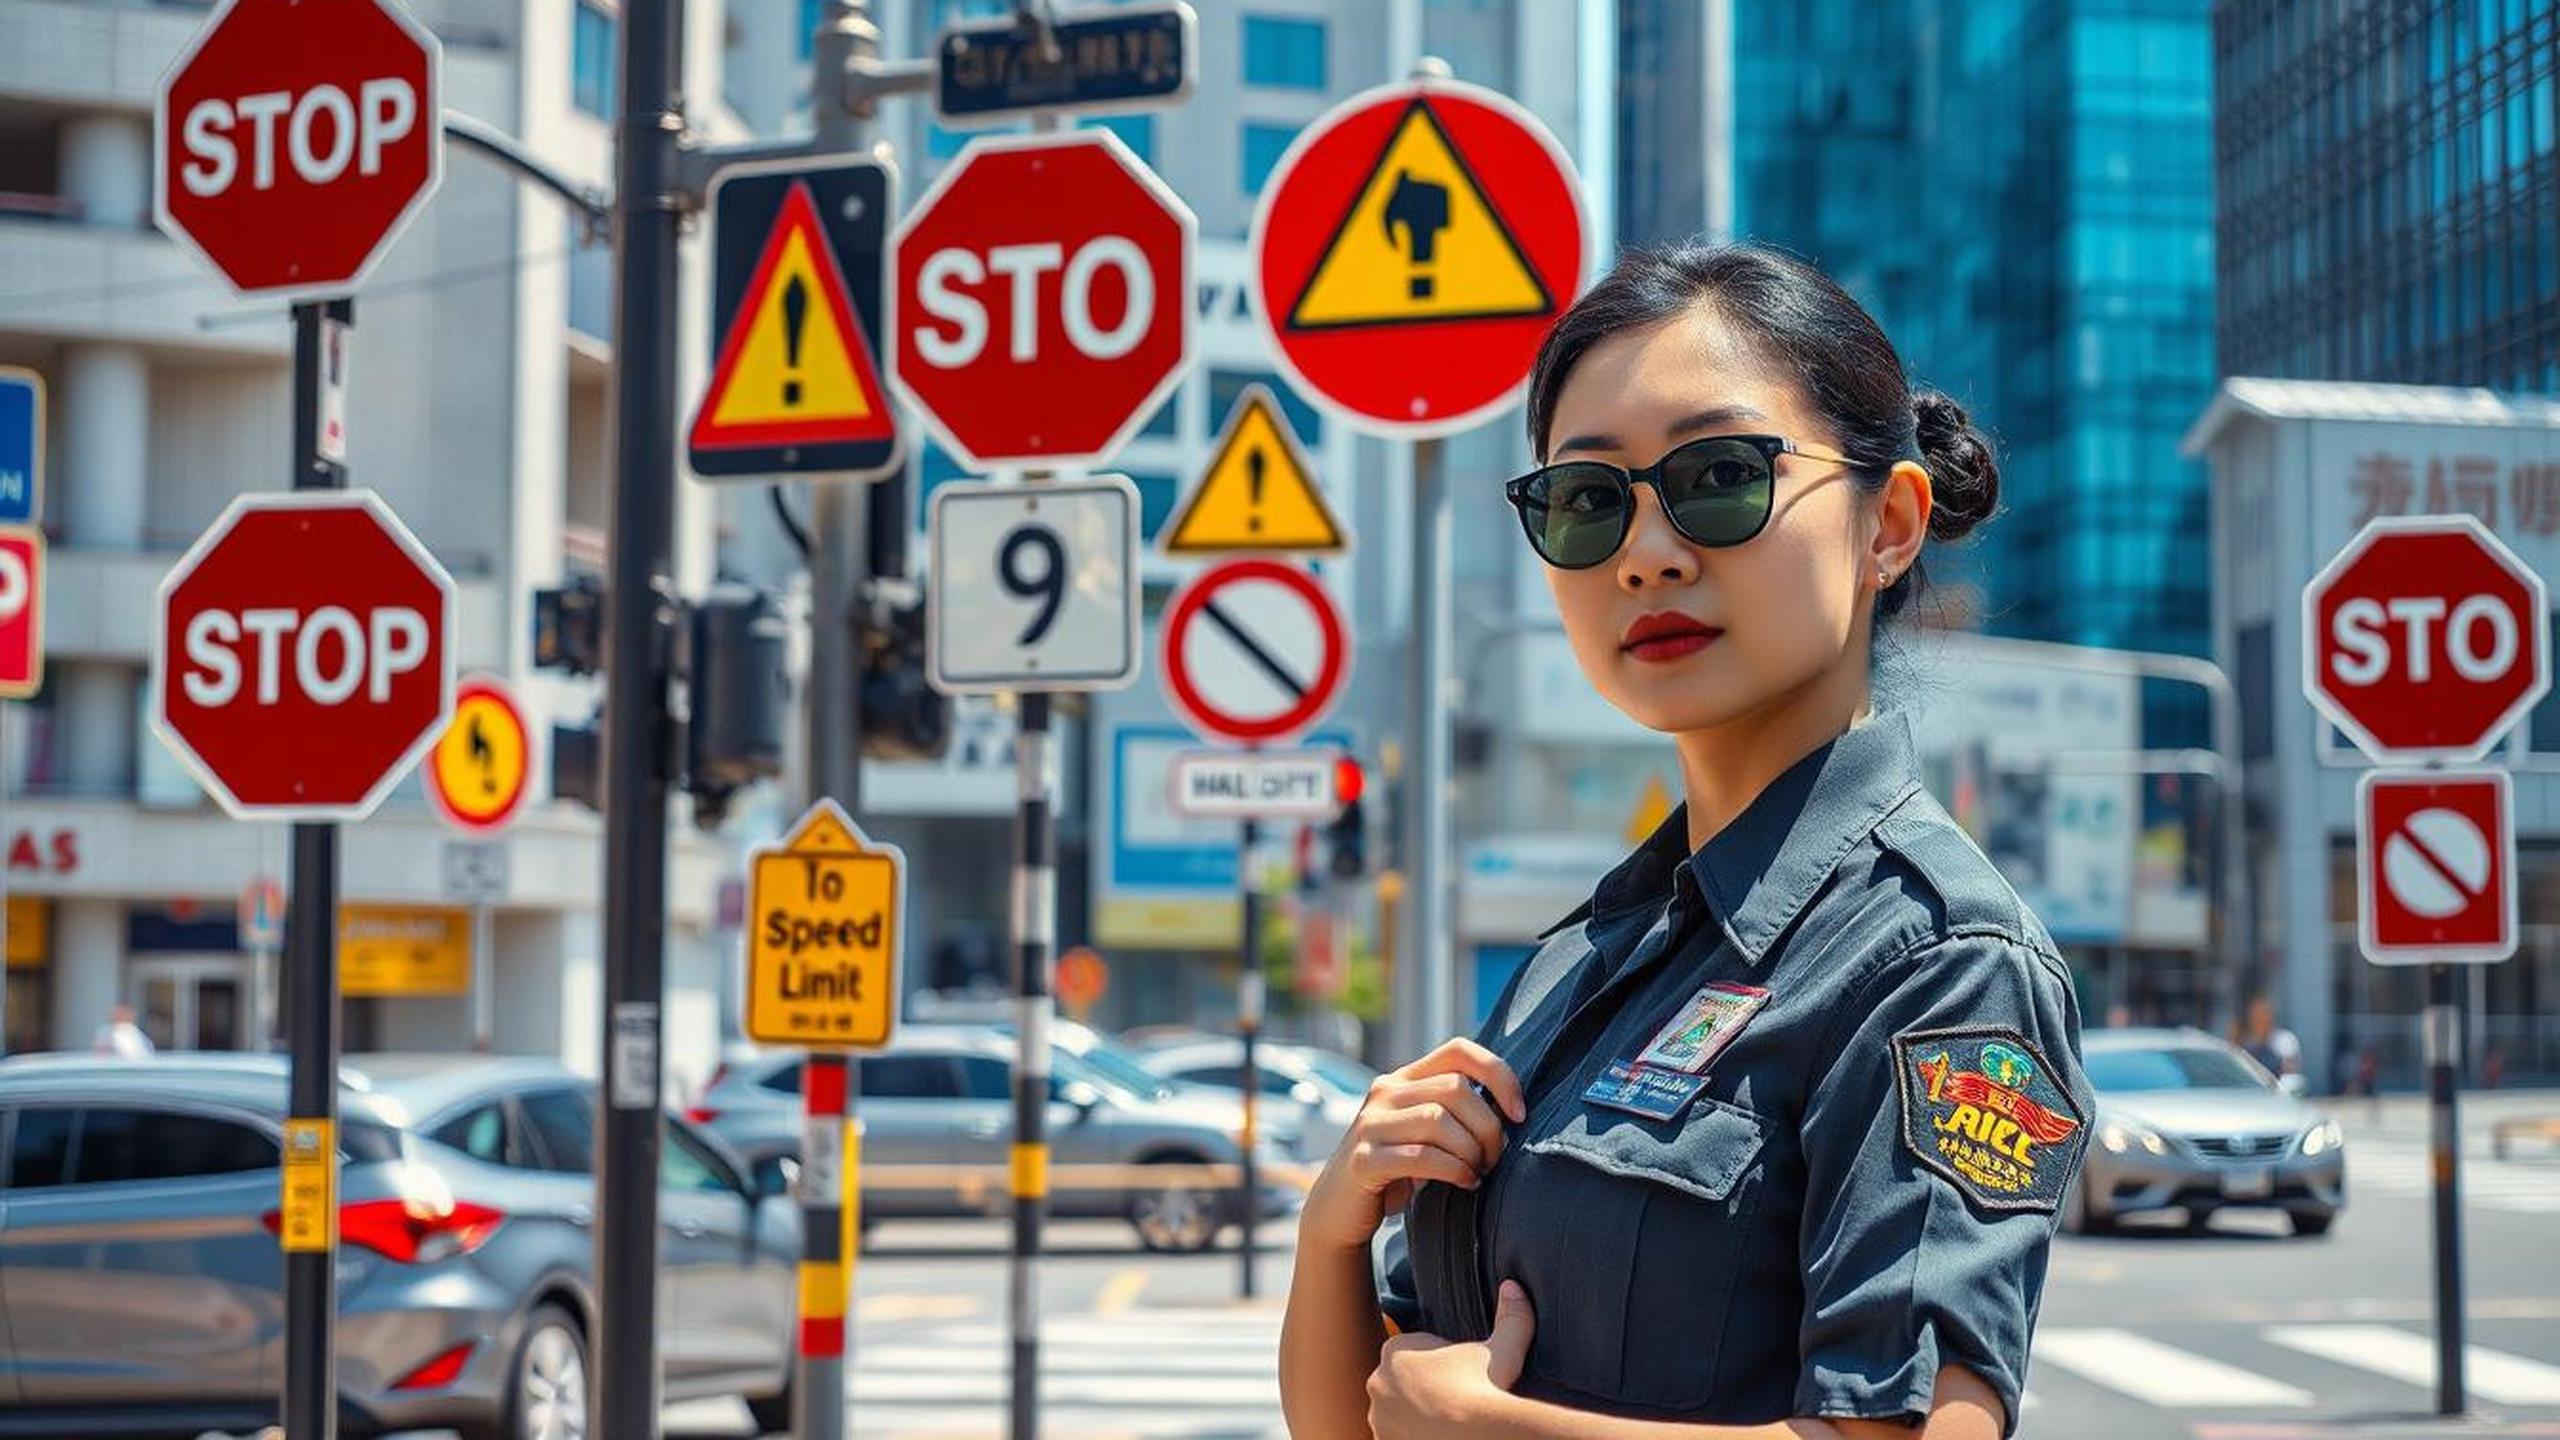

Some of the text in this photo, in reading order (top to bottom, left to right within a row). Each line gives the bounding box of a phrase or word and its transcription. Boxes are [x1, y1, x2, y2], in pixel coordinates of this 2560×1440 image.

[182, 76, 416, 197] STOP
[914, 235, 1156, 369] STO
[999, 526, 1066, 648] 9
[183, 606, 429, 707] STOP
[2330, 593, 2520, 686] STO
[803, 858, 845, 902] To
[765, 909, 884, 955] Speed
[778, 962, 862, 1001] Limit
